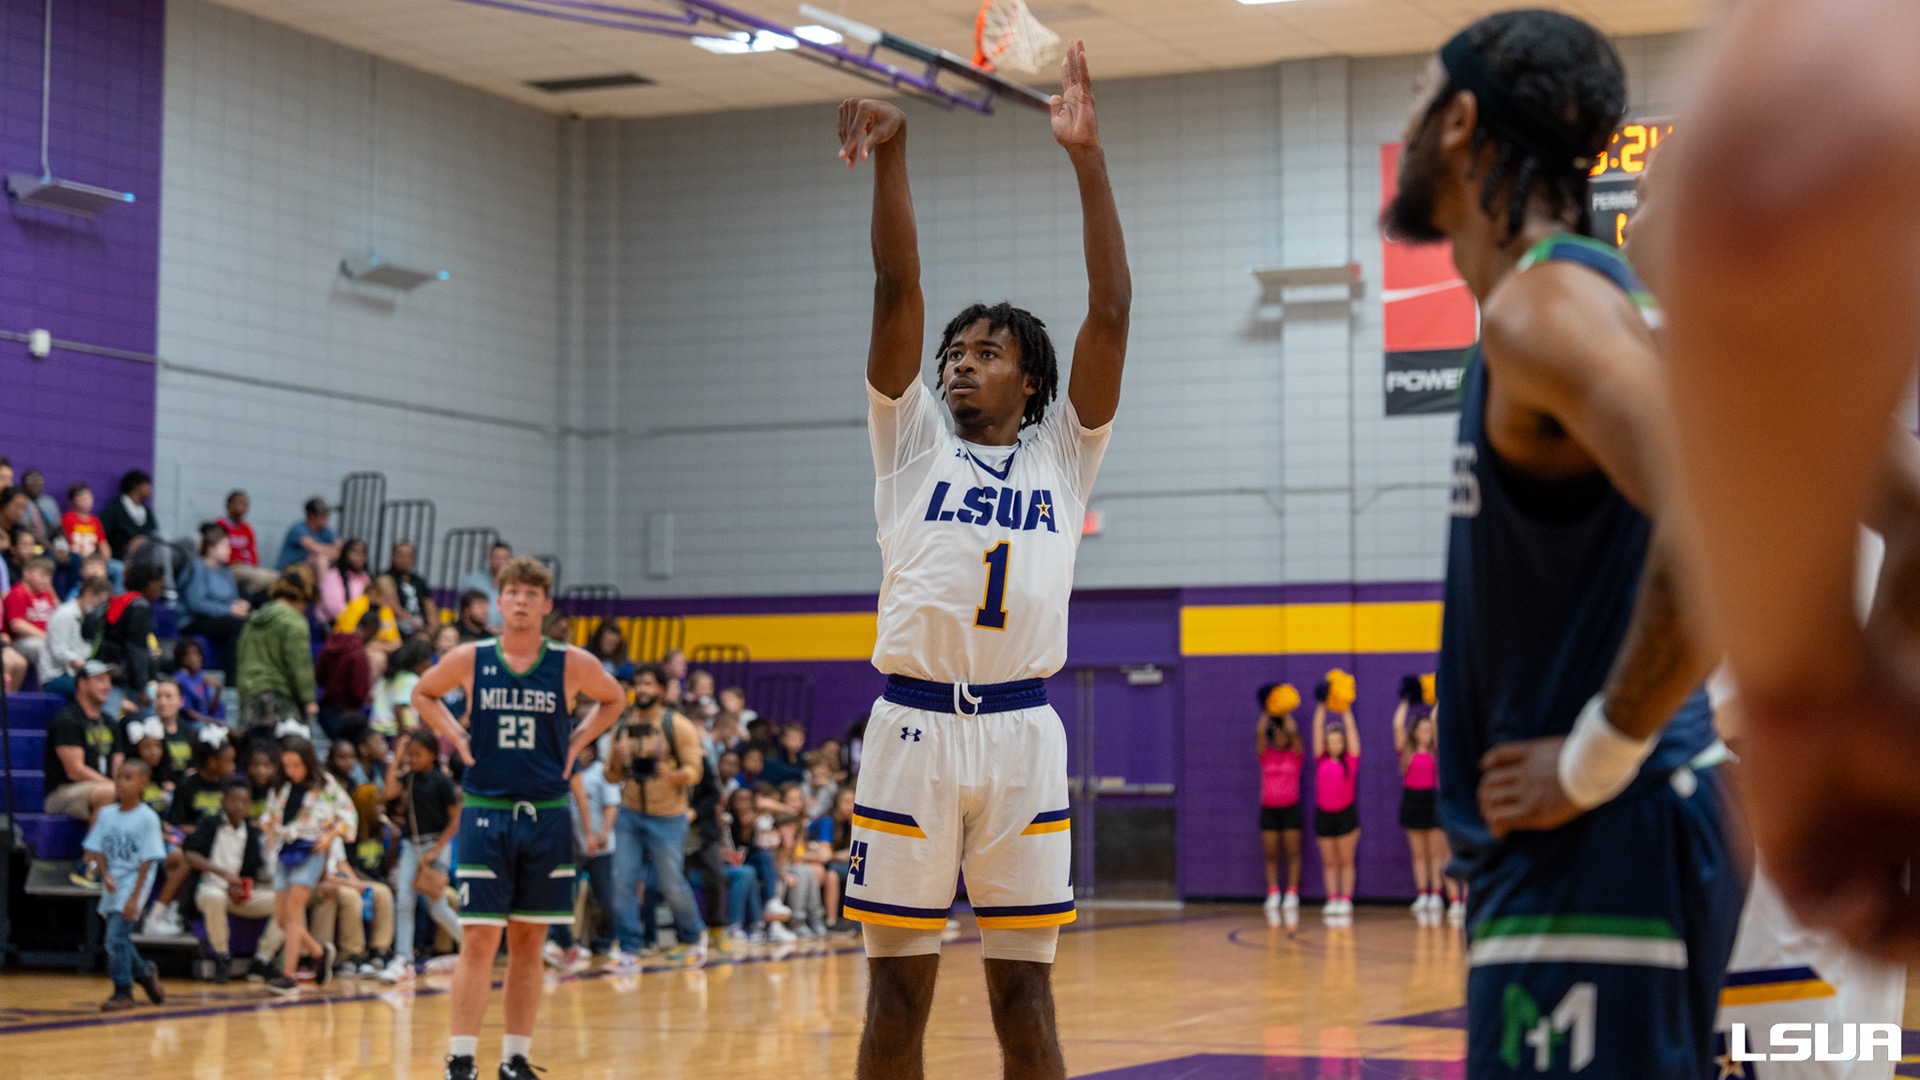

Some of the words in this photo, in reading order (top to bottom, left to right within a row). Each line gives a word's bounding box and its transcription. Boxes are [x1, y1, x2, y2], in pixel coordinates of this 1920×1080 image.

[1386, 368, 1465, 393] POWE
[924, 481, 1056, 533] LSUA
[973, 540, 1011, 631] 1
[480, 687, 556, 714] MILLERS
[498, 715, 536, 750] 23
